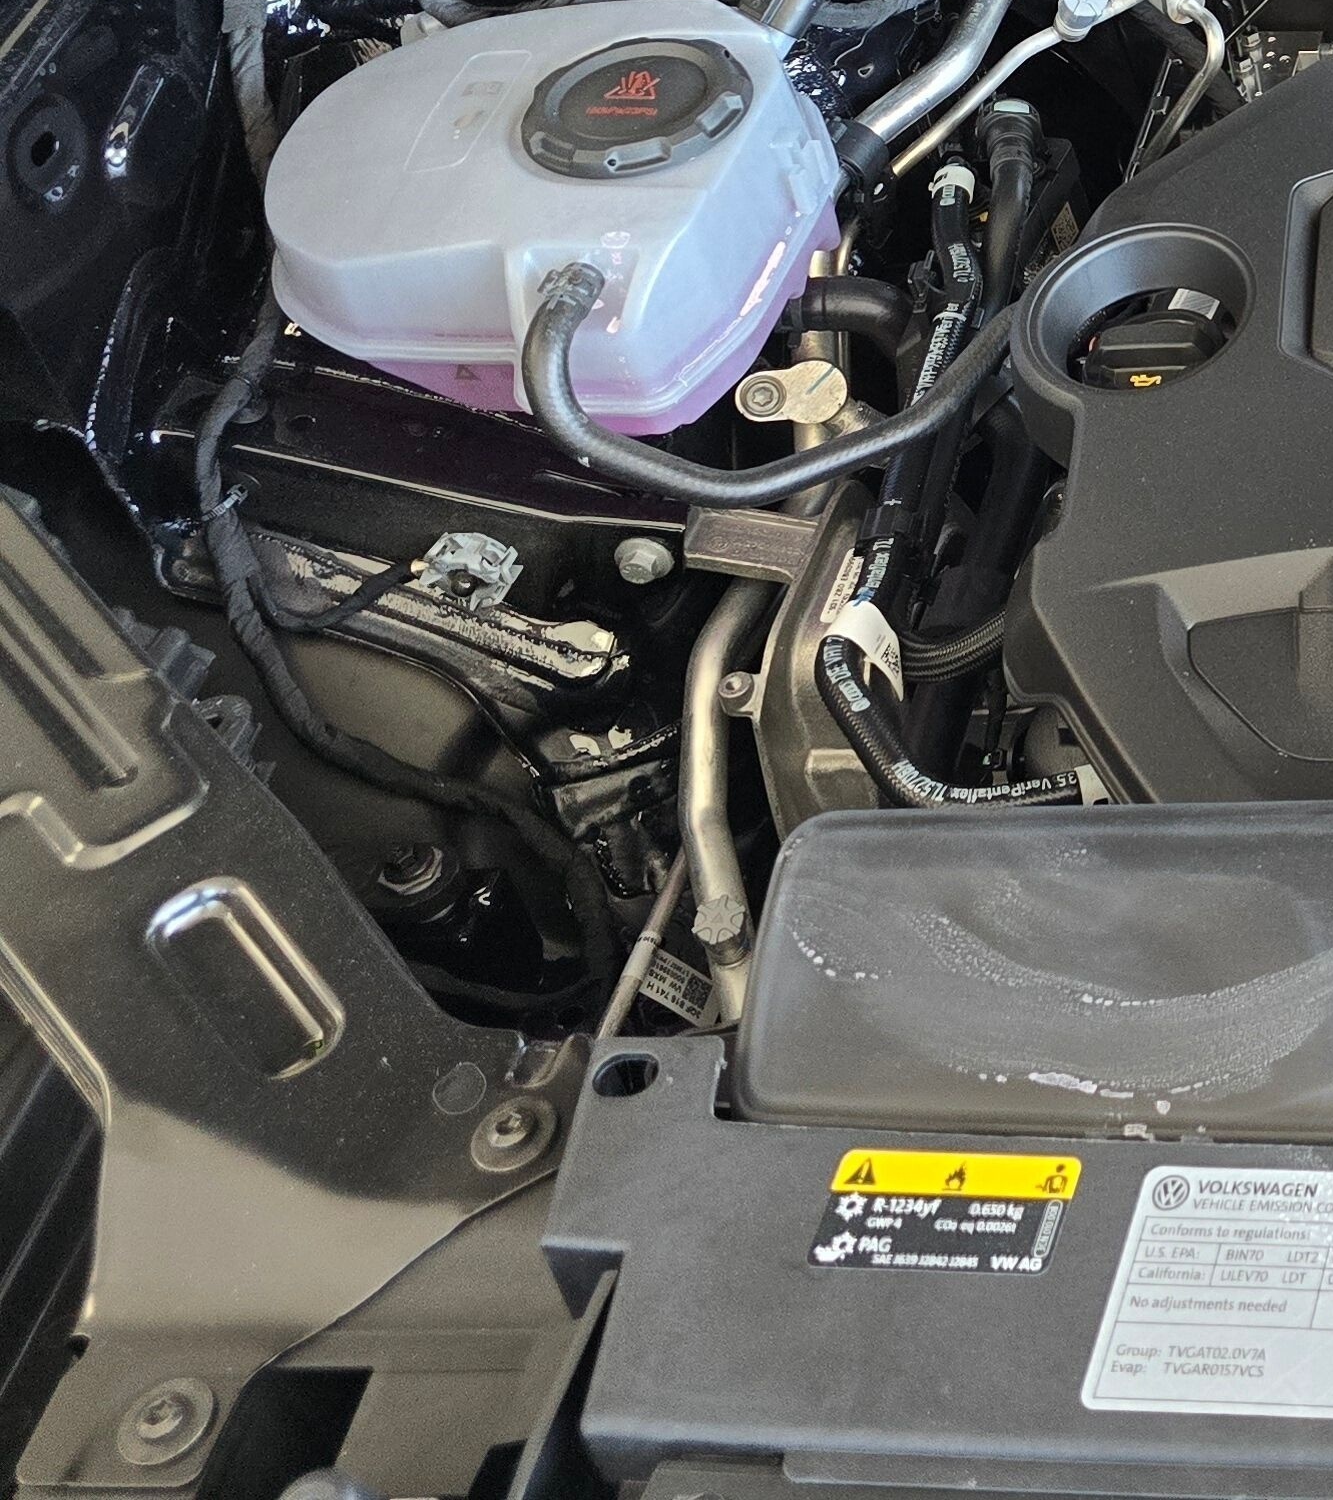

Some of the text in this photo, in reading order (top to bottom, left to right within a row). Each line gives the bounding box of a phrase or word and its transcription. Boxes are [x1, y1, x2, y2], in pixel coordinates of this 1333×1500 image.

[1199, 1180, 1319, 1198] VOLKSWAGEN
[872, 1199, 1024, 1221] R-1234yf 0.650 kg
[1193, 1199, 1245, 1211] VEHICLE
[1250, 1201, 1313, 1213] EMISSION
[867, 1218, 894, 1229] GWP
[895, 1218, 903, 1229] 4
[1150, 1224, 1213, 1237] Conforms
[1217, 1225, 1230, 1238] to
[1234, 1226, 1311, 1241] regulations:
[858, 1236, 892, 1253] PAG
[872, 1254, 1042, 1271] SAE VW AG
[1145, 1245, 1166, 1258] U.S.
[1171, 1246, 1200, 1259] EPA:
[1226, 1249, 1264, 1262] BIN70
[1287, 1251, 1319, 1263] LDT2
[1138, 1266, 1205, 1281] California:
[1220, 1268, 1268, 1282] ULEV70
[1282, 1271, 1307, 1284] LDT
[1130, 1295, 1287, 1313] No adjustments needed
[1116, 1344, 1161, 1359] Group:
[1111, 1360, 1146, 1375] Evap:
